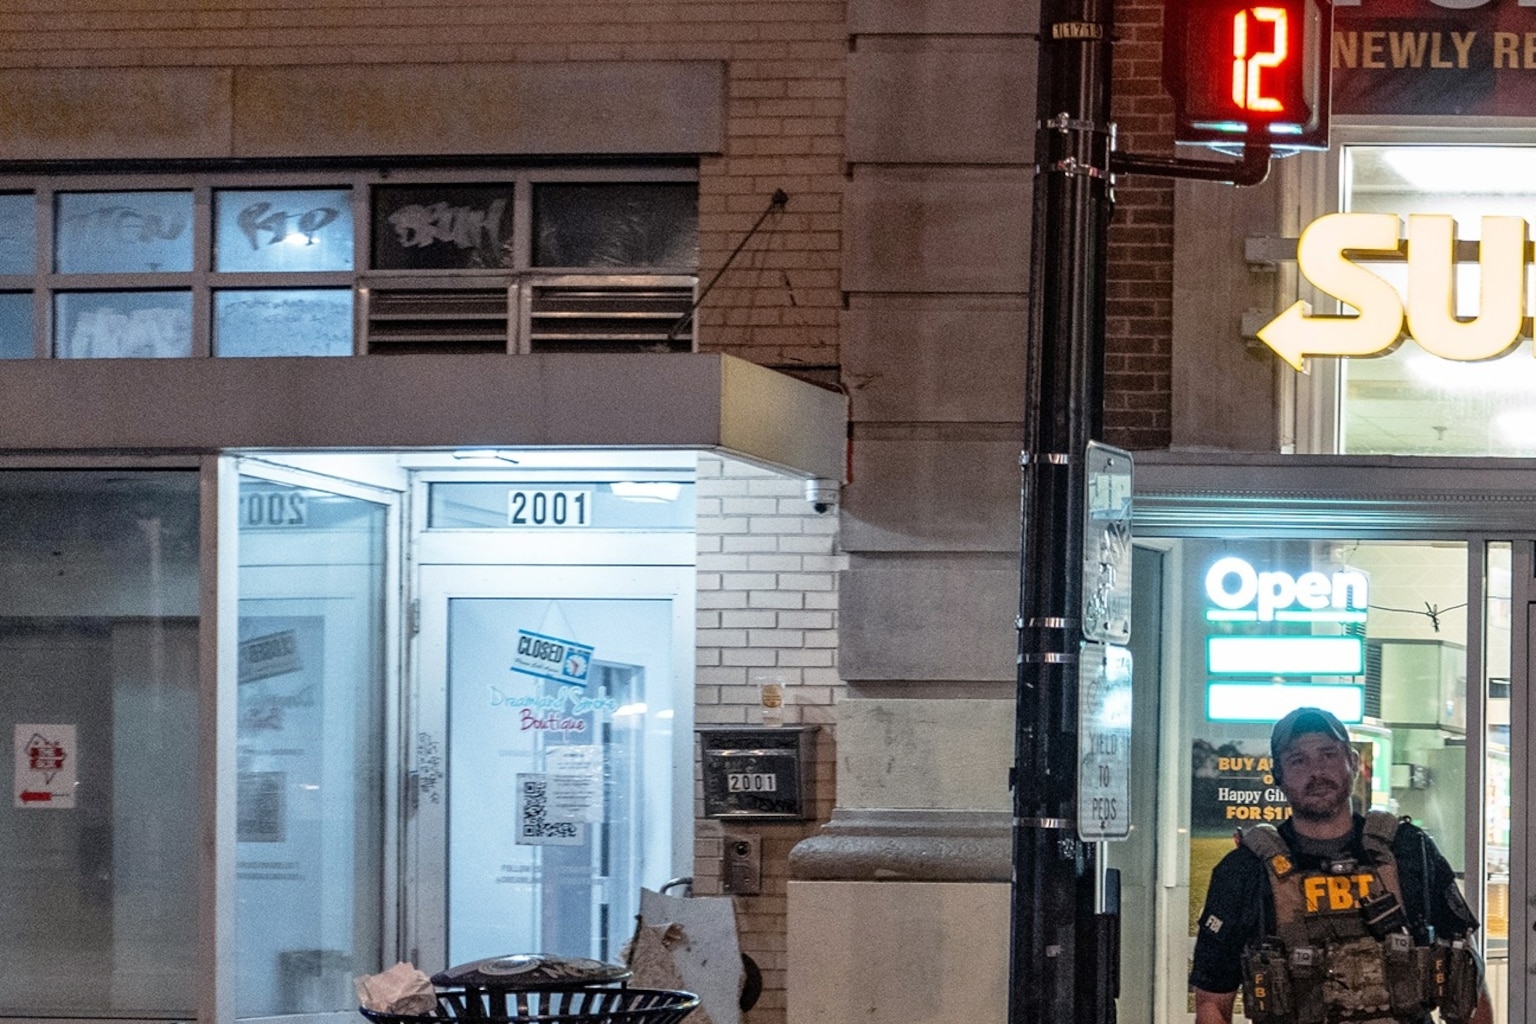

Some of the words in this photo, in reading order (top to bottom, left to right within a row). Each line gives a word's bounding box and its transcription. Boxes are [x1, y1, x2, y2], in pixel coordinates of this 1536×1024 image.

[1232, 7, 1287, 111] 12
[1331, 31, 1477, 70] NEWLY
[512, 491, 585, 525] 2001
[1205, 556, 1369, 622] Open
[517, 635, 565, 663] CLOSED
[519, 708, 586, 742] Boutique
[1089, 731, 1118, 755] YIELD
[1098, 765, 1110, 788] TO
[1218, 757, 1255, 772] BUY
[731, 775, 773, 789] 2001
[1092, 797, 1117, 820] PEDS
[1218, 787, 1262, 805] Happy
[1226, 806, 1262, 820] FOR
[1205, 914, 1224, 934] FBI
[1435, 959, 1444, 996] FBI
[1254, 972, 1267, 1012] FBI
